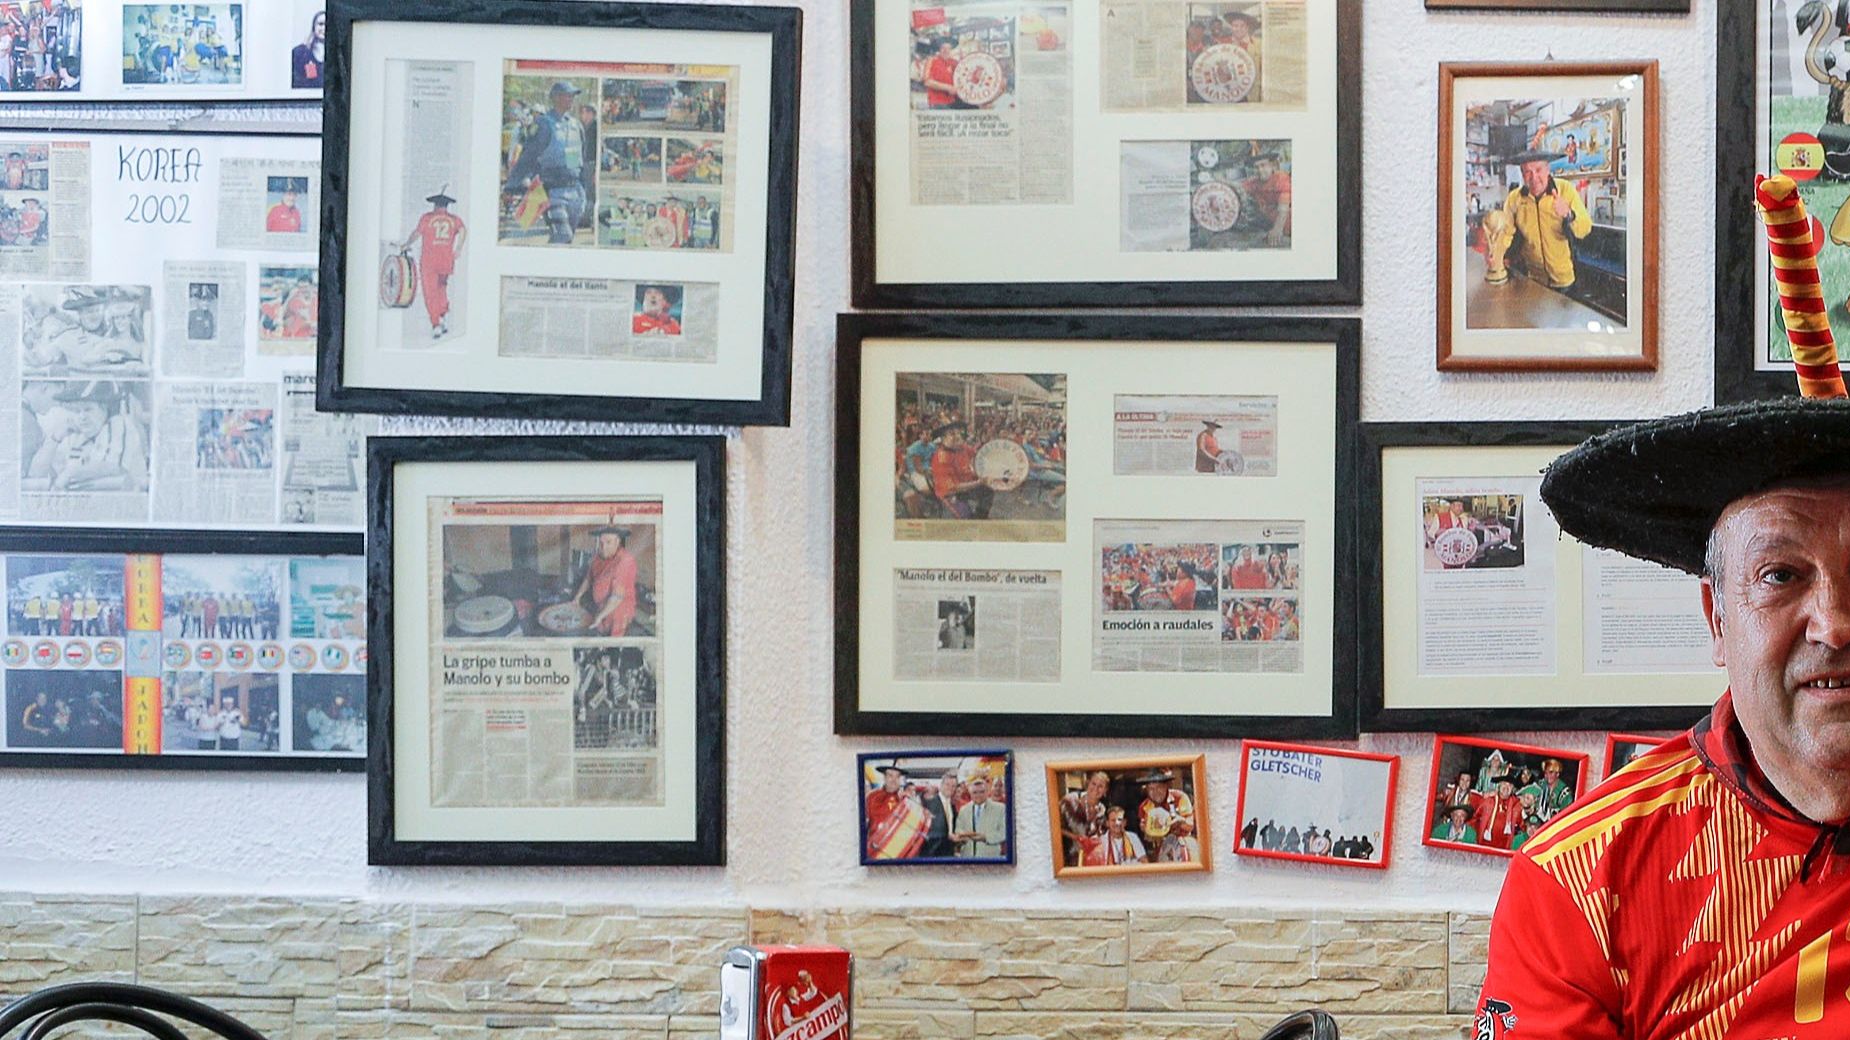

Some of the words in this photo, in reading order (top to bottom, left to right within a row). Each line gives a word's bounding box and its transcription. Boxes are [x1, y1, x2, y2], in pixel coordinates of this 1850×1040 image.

[118, 144, 204, 184] KOREA
[124, 194, 192, 223] 2002
[937, 571, 946, 582] el
[948, 572, 962, 582] del
[1005, 573, 1017, 583] de
[1019, 573, 1047, 584] vuelta
[1102, 618, 1151, 631] Emoción
[1153, 621, 1160, 630] a
[1163, 619, 1214, 631] raudales
[443, 655, 459, 669] La
[462, 655, 496, 674] gripe
[500, 655, 540, 669] tumba
[543, 658, 551, 669] a
[443, 672, 491, 686] Manolo
[494, 675, 502, 687] y
[506, 675, 521, 686] su
[524, 672, 570, 686] bombo
[1250, 759, 1322, 782] GLETSCHER
